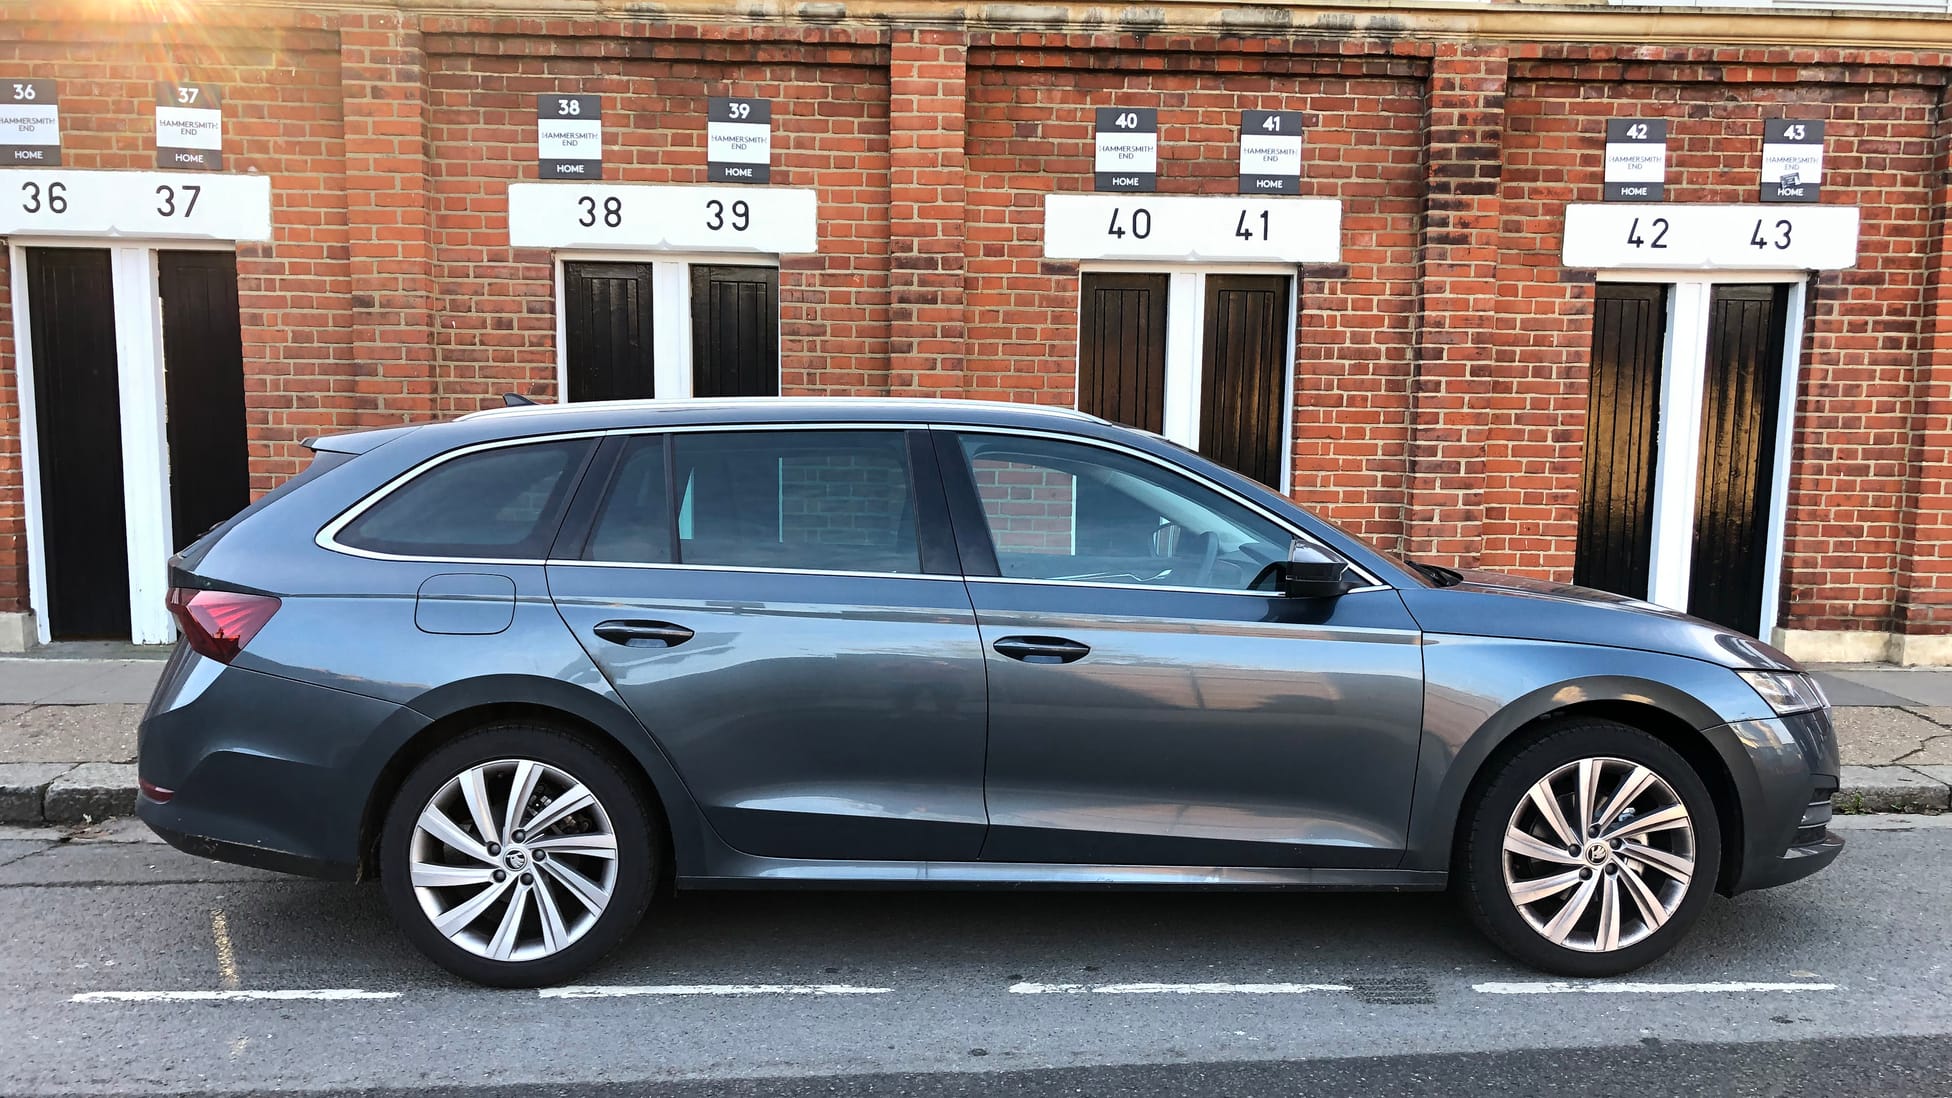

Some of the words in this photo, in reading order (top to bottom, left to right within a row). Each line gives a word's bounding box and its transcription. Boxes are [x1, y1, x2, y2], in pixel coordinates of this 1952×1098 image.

[13, 84, 35, 99] 36
[178, 87, 198, 103] 37
[559, 100, 580, 115] 38
[729, 103, 750, 118] 39
[160, 120, 219, 129] HAMMERSMITH
[1115, 113, 1137, 128] 40
[1263, 116, 1280, 131] 41
[180, 127, 197, 136] END
[542, 132, 598, 140] HAMMERSMITH
[1627, 124, 1647, 139] 42
[1784, 125, 1805, 140] 43
[712, 135, 767, 144] HAMMERSMITH
[15, 151, 43, 159] HOME
[176, 154, 204, 163] HOME
[1766, 156, 1819, 164] HAMMERSMITH
[557, 165, 584, 173] HOME
[725, 168, 752, 176] HOME
[1257, 180, 1283, 188] HOME
[22, 182, 67, 213] 36
[156, 185, 200, 217] 37
[1778, 188, 1804, 196] HOME
[578, 196, 621, 227] 38
[706, 200, 749, 231] 39
[1108, 208, 1151, 239] 40
[1235, 210, 1268, 240] 41
[1627, 218, 1669, 248] 42
[1750, 219, 1792, 249] 43
